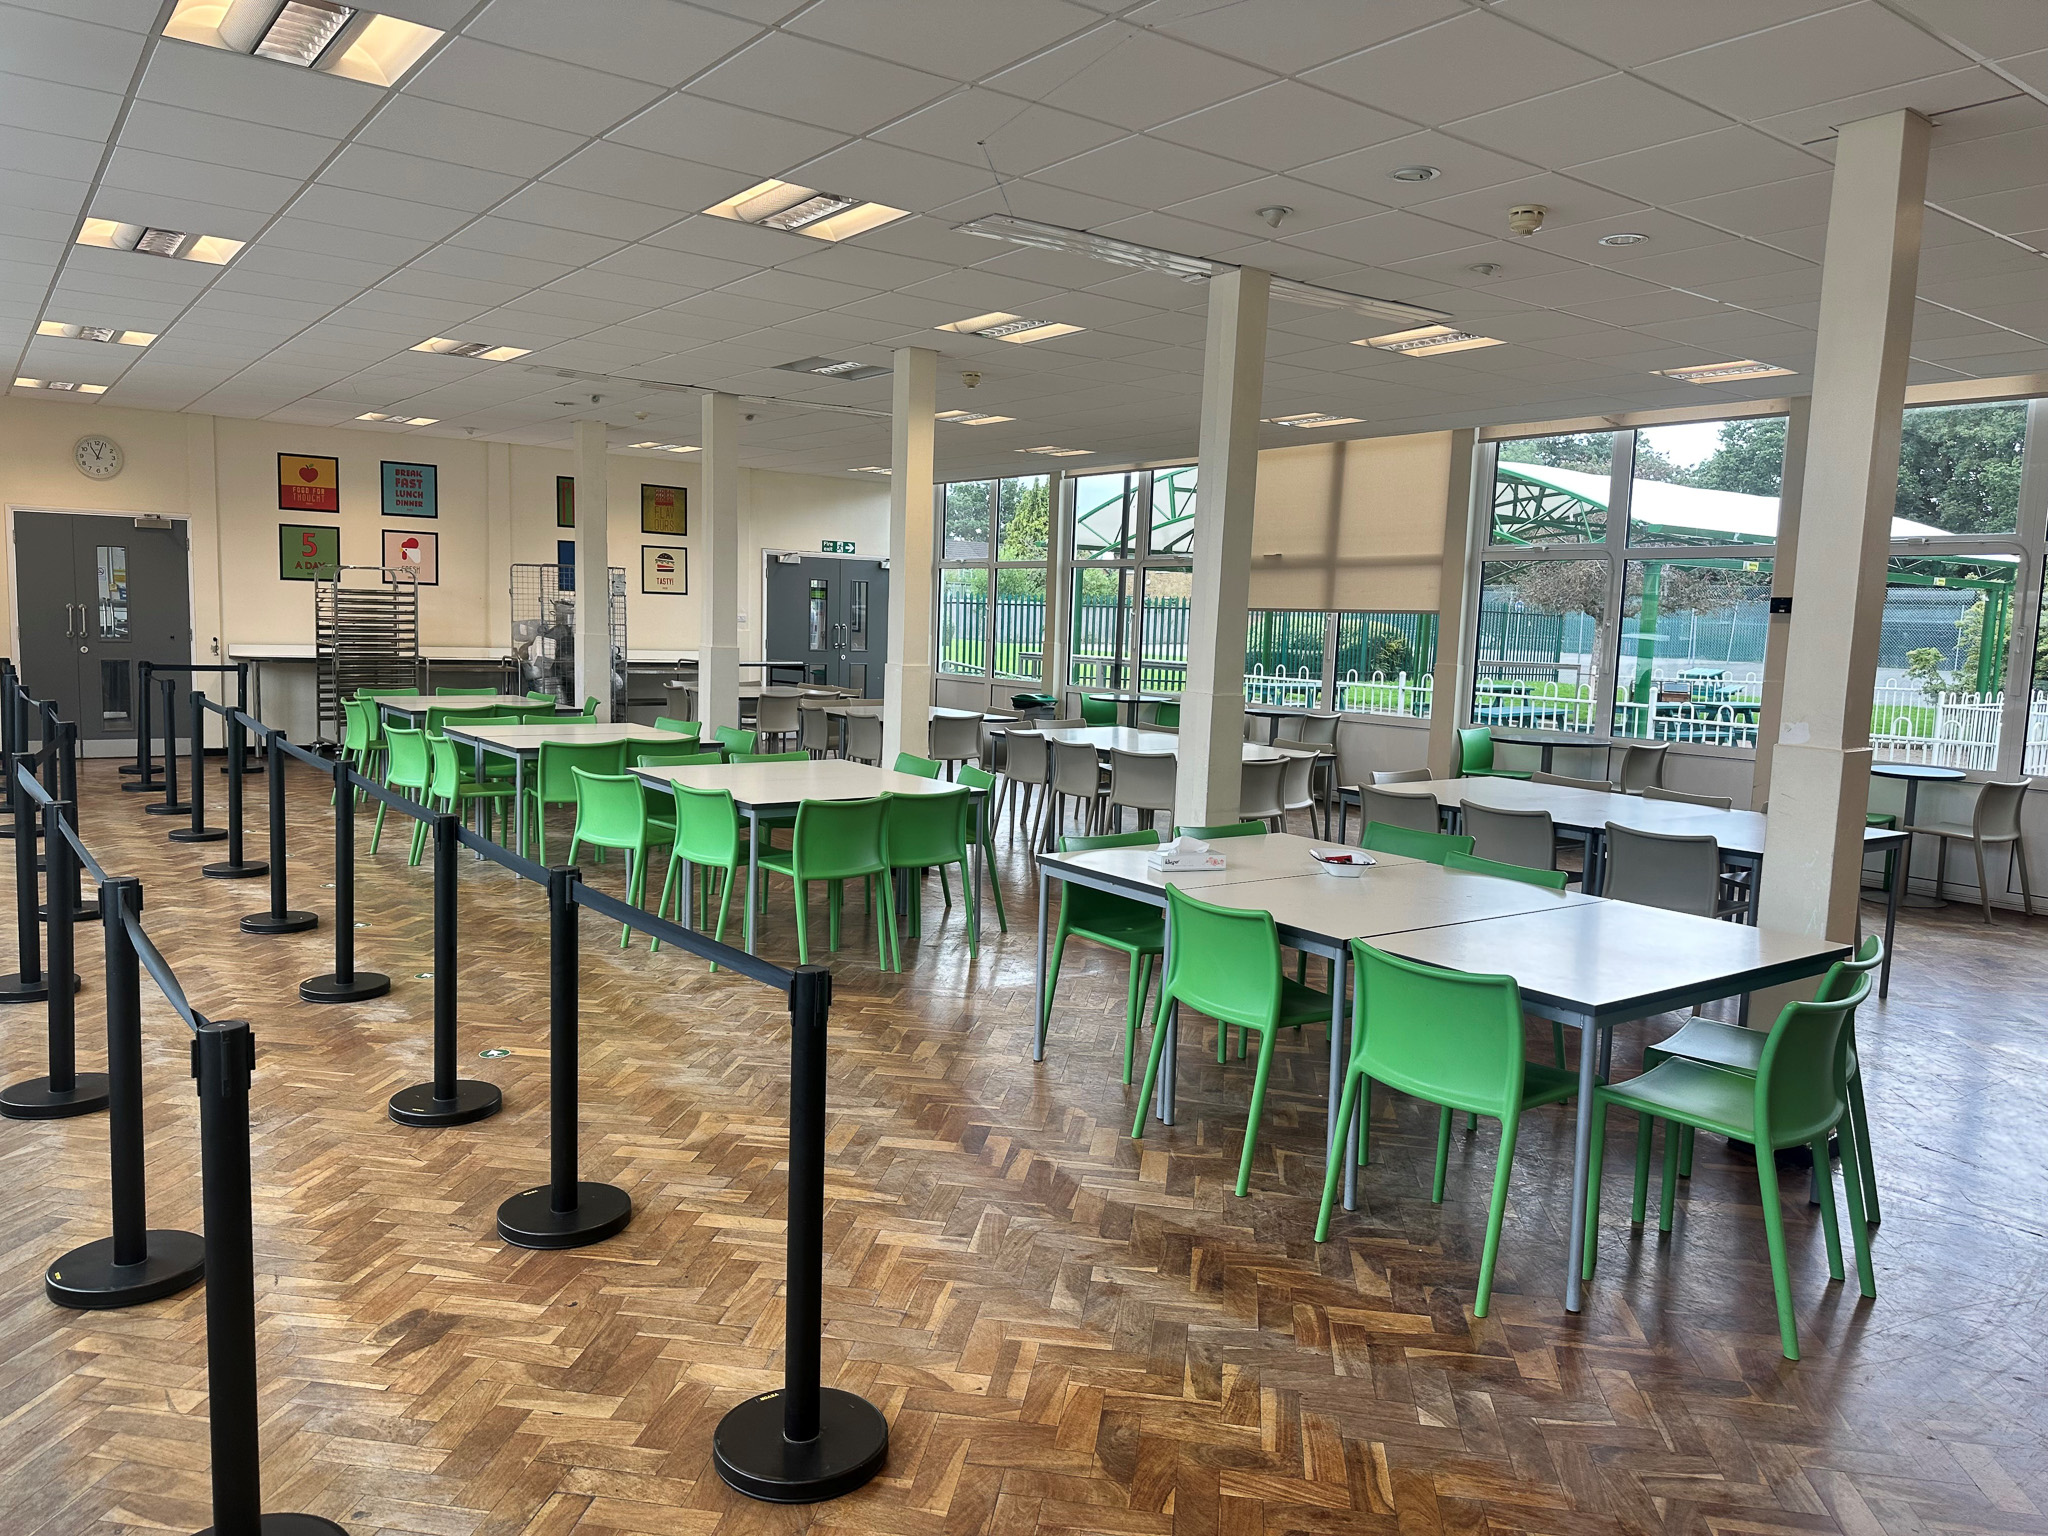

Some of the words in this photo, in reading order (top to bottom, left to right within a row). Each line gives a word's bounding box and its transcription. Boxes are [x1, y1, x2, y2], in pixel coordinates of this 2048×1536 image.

[395, 468, 423, 478] BREAK
[395, 477, 424, 489] FAST
[292, 486, 310, 494] FOOD
[312, 487, 325, 495] FOR
[395, 490, 424, 499] LUNCH
[292, 493, 326, 503] THOUGHT
[395, 499, 424, 507] DINNER
[654, 505, 675, 519] FLAV
[654, 518, 675, 531] OURS
[302, 532, 318, 557] 5
[295, 560, 303, 570] A
[304, 561, 326, 570] DAY
[656, 577, 674, 586] TASTY!
